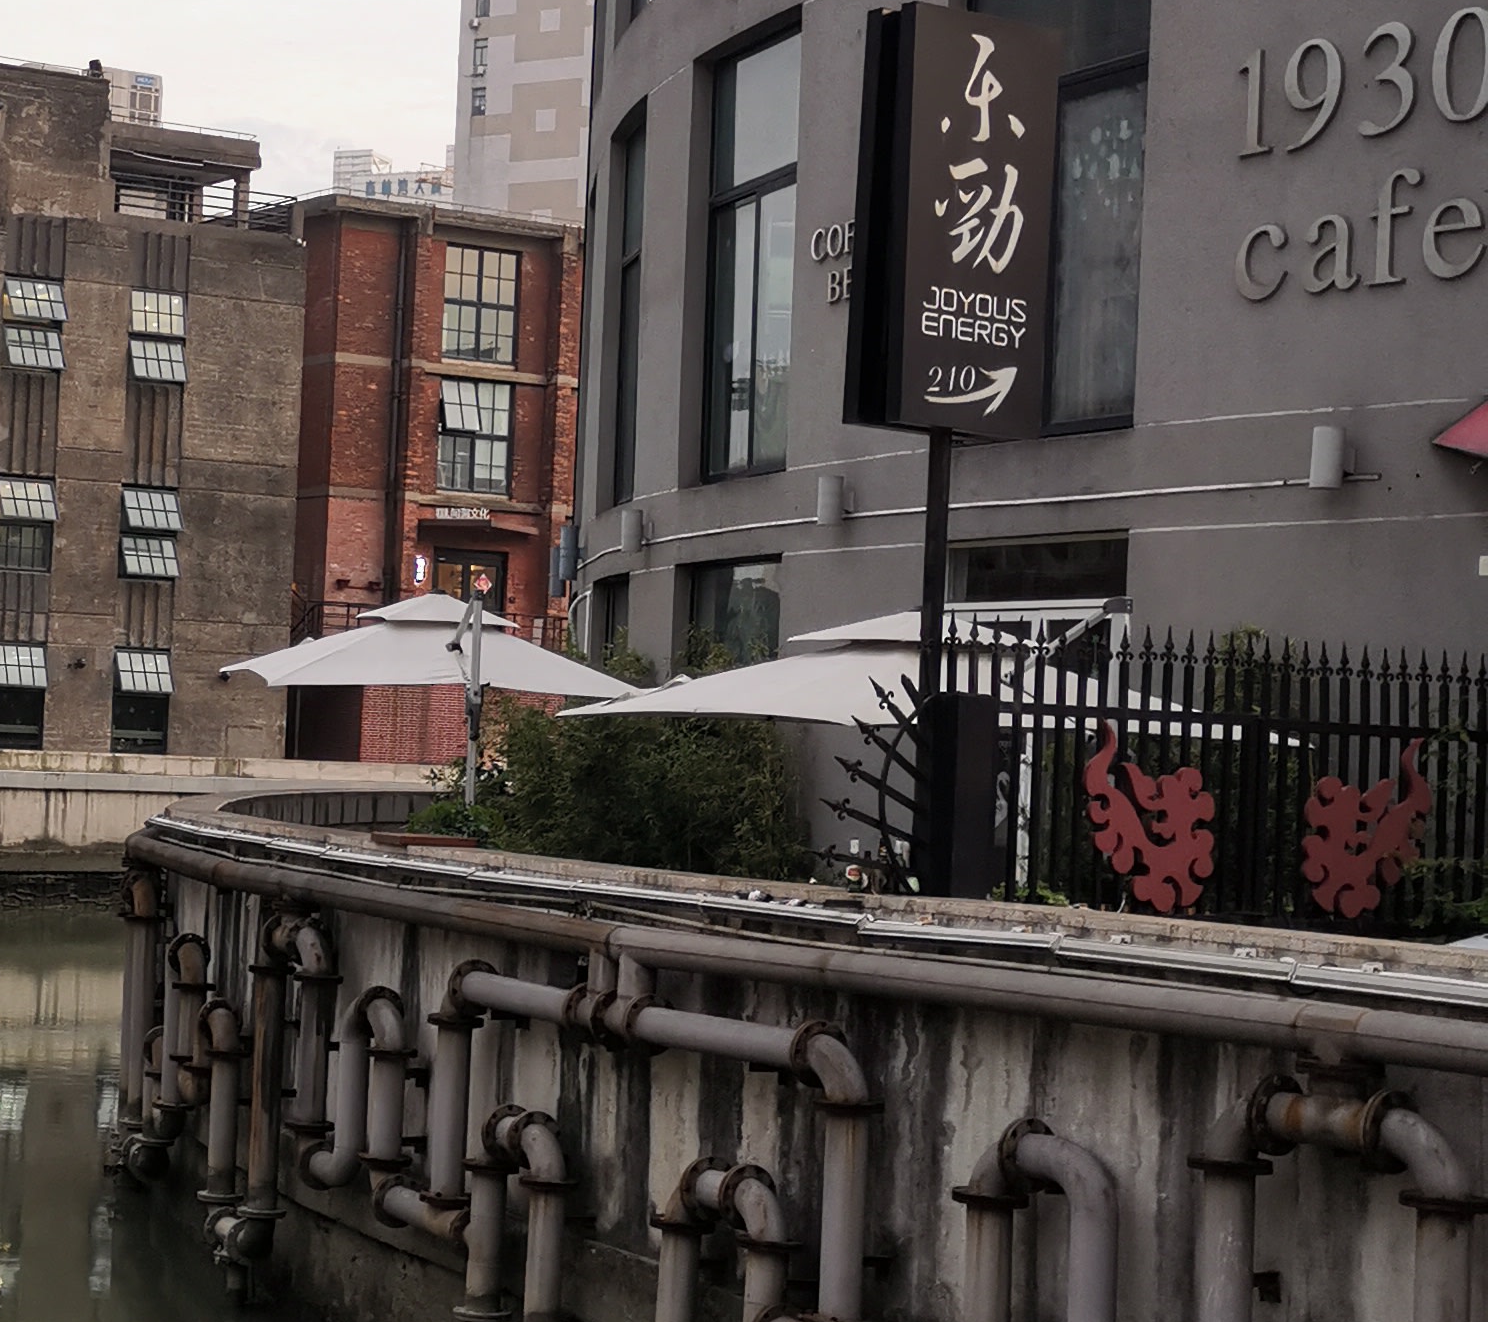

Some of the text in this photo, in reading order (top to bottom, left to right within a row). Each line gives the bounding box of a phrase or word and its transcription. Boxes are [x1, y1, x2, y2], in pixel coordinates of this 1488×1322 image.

[1239, 7, 1488, 157] 1930
[1234, 168, 1487, 300] cafe
[922, 285, 1027, 322] JOYOUS
[921, 311, 1027, 349] ENERGY
[926, 365, 976, 392] 210
